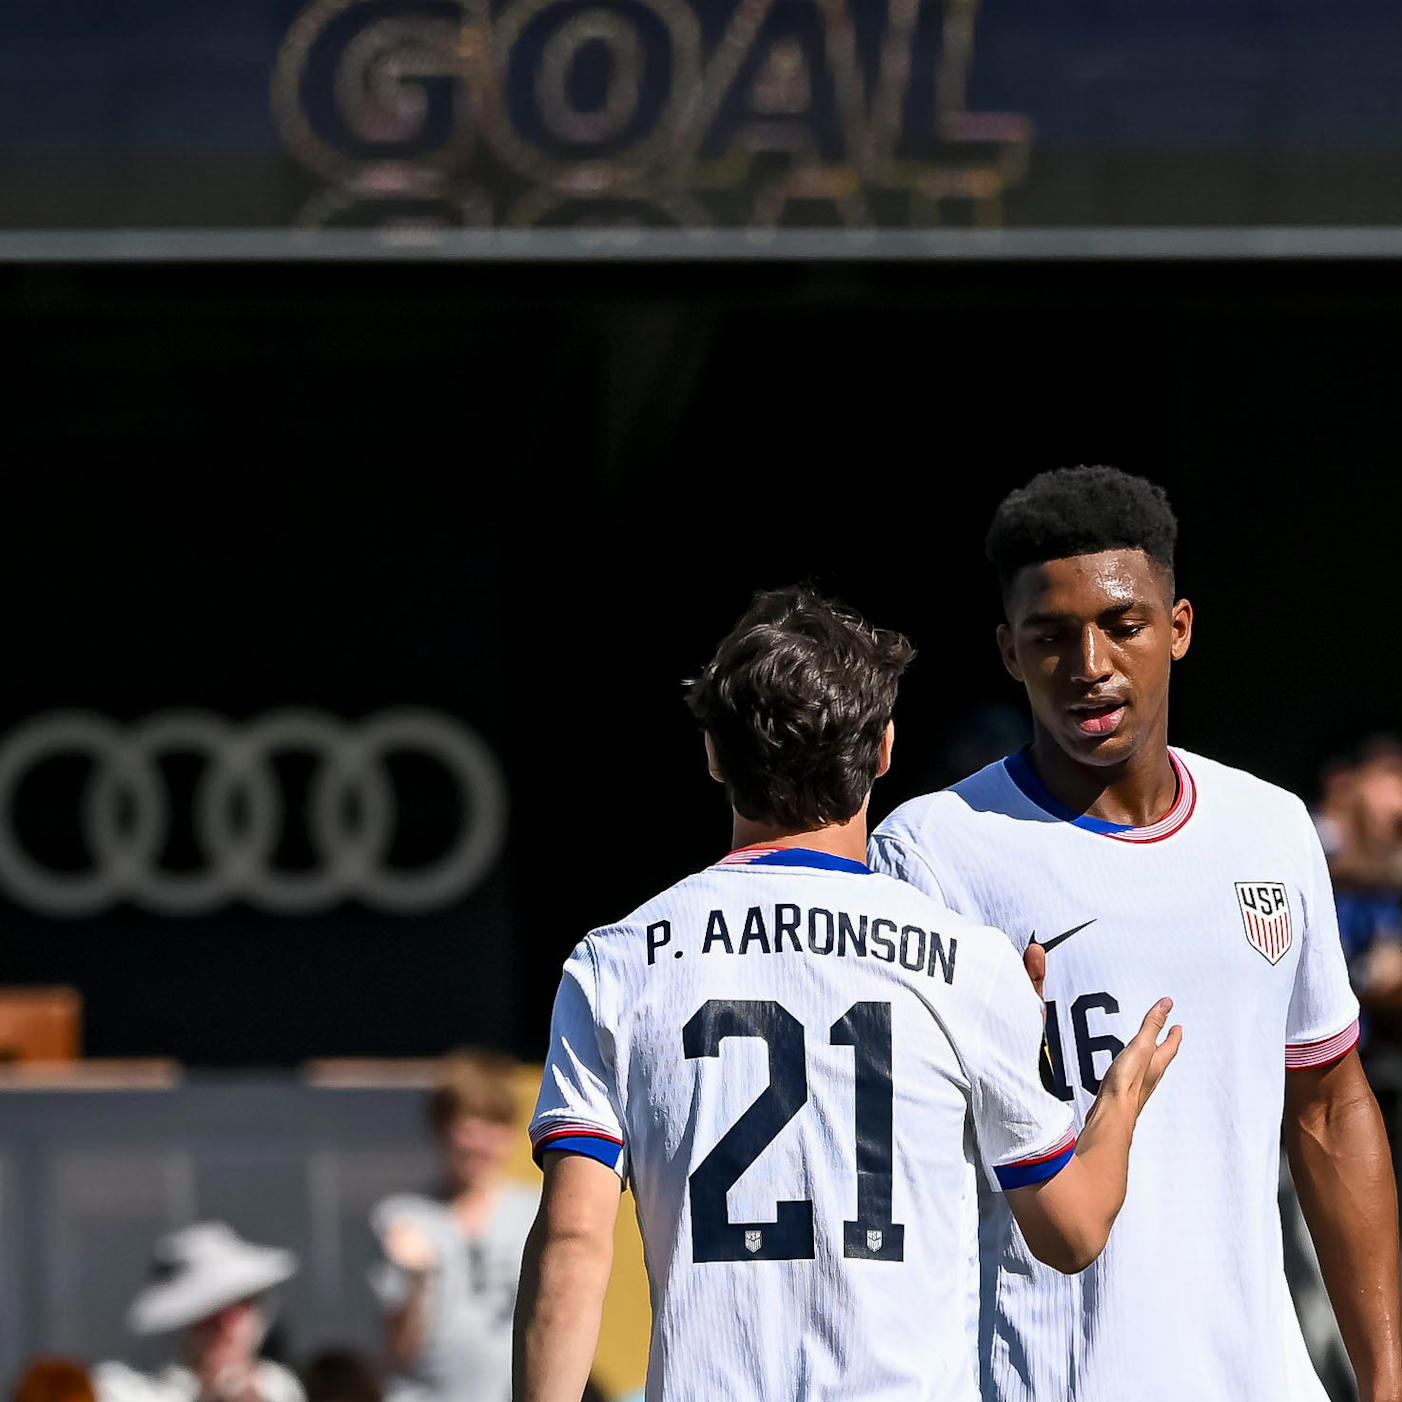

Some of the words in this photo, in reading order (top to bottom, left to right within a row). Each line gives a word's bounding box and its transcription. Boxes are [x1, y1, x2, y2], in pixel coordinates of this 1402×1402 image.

[272, 0, 1031, 194] GOAL
[646, 920, 683, 965] P.
[702, 903, 957, 984] AARONSON
[1243, 887, 1286, 915] USA
[1040, 991, 1126, 1102] 16
[682, 1000, 904, 1263] 21
